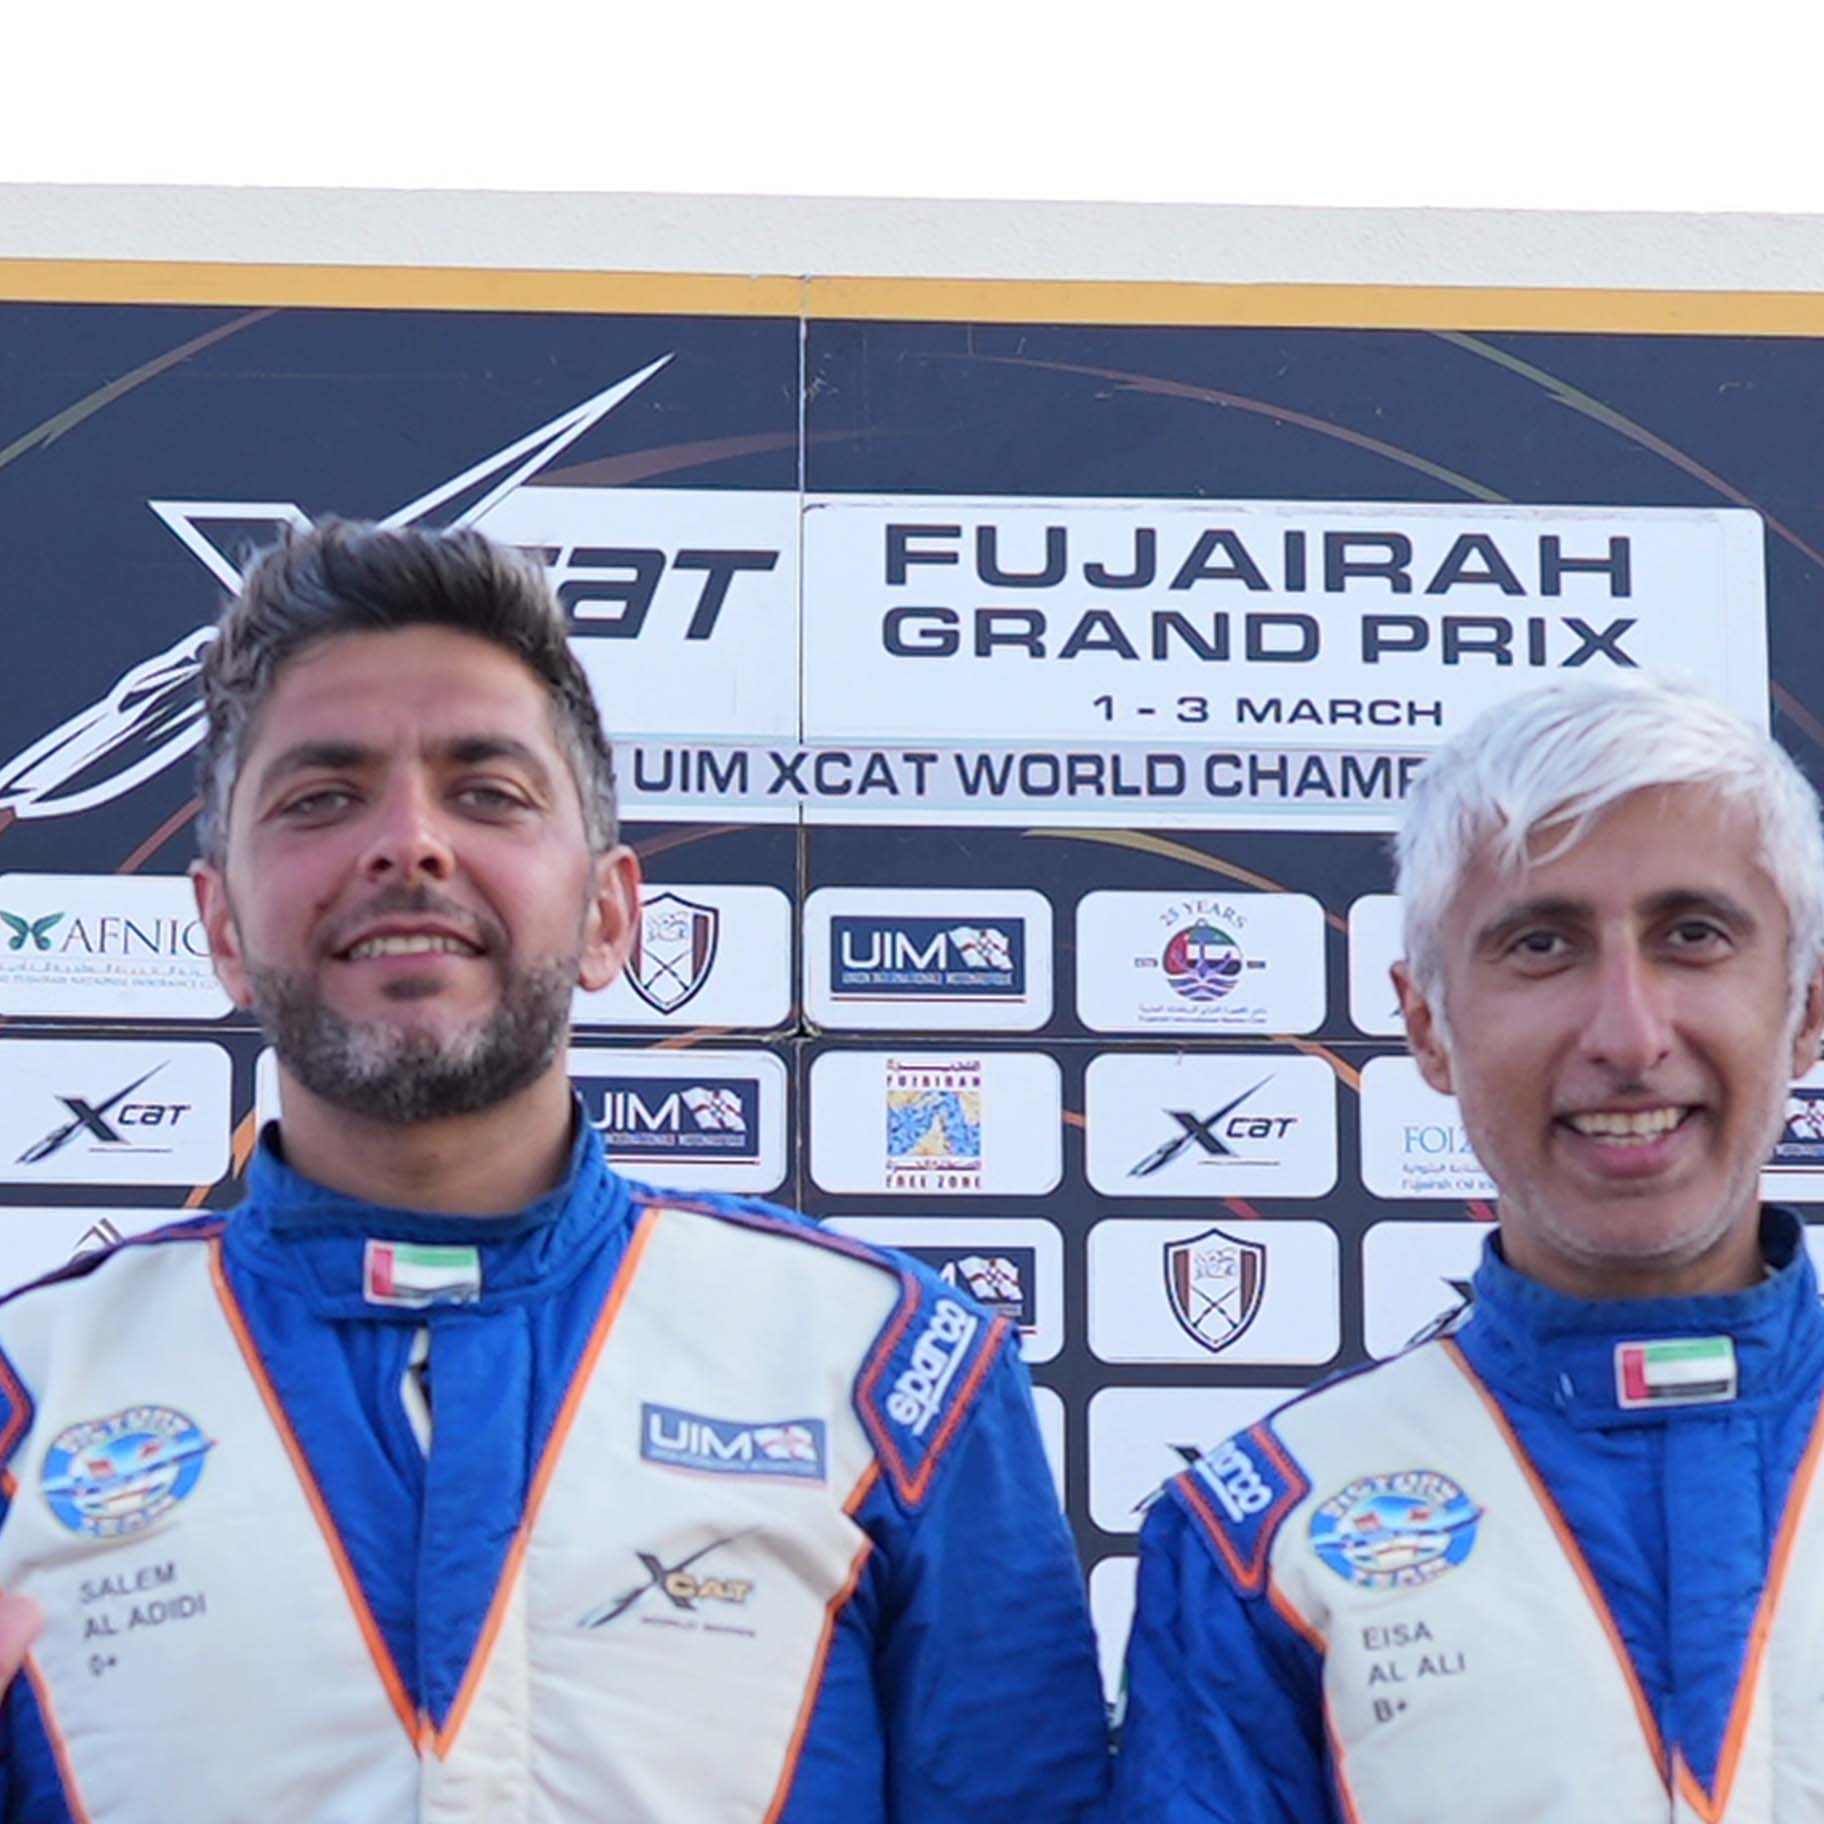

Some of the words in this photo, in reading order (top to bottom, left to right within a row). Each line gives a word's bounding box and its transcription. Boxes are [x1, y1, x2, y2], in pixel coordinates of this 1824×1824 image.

[884, 523, 1633, 599] FUJAIRAH
[881, 606, 1321, 662] GRAND
[1361, 615, 1641, 668] PRIX
[1092, 695, 1115, 721] 1
[1177, 696, 1210, 724] 3
[1235, 697, 1443, 727] MARCH
[634, 748, 749, 793] UIM
[766, 751, 939, 797] XCAT
[960, 753, 1185, 798] WORLD
[842, 931, 947, 970] UIM
[650, 1413, 753, 1460] UIM
[80, 1563, 177, 1605] SALEM
[83, 1613, 119, 1641] AL
[128, 1593, 208, 1633] ADIDI
[1363, 1620, 1434, 1651] EISA
[1368, 1662, 1406, 1687] AL
[1416, 1651, 1467, 1679] ALI
